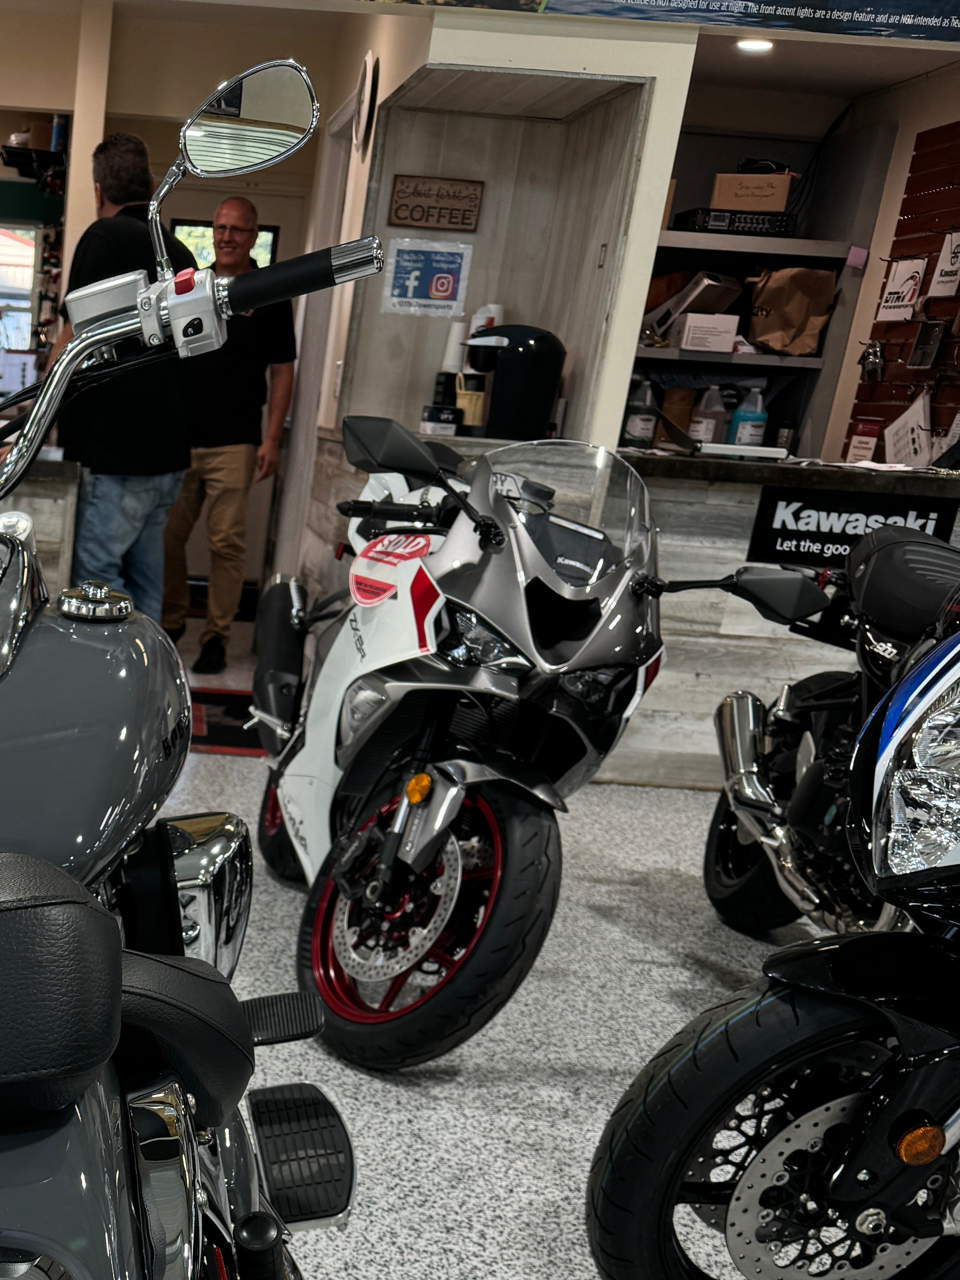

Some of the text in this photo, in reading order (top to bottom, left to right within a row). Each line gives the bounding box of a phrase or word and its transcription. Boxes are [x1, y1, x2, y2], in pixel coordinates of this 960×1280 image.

[709, 2, 720, 10] use
[721, 2, 728, 11] at
[748, 3, 758, 13] The
[759, 4, 775, 14] front
[776, 7, 796, 16] accent
[797, 6, 814, 18] lights
[815, 9, 825, 18] are
[831, 9, 852, 21] design
[852, 11, 874, 22] feature
[876, 13, 888, 23] and
[889, 14, 899, 24] are
[914, 14, 941, 26] intended
[942, 18, 950, 27] as
[394, 203, 474, 226] COFFEE
[377, 534, 427, 554] SOLD
[776, 538, 850, 557] Let the goo
